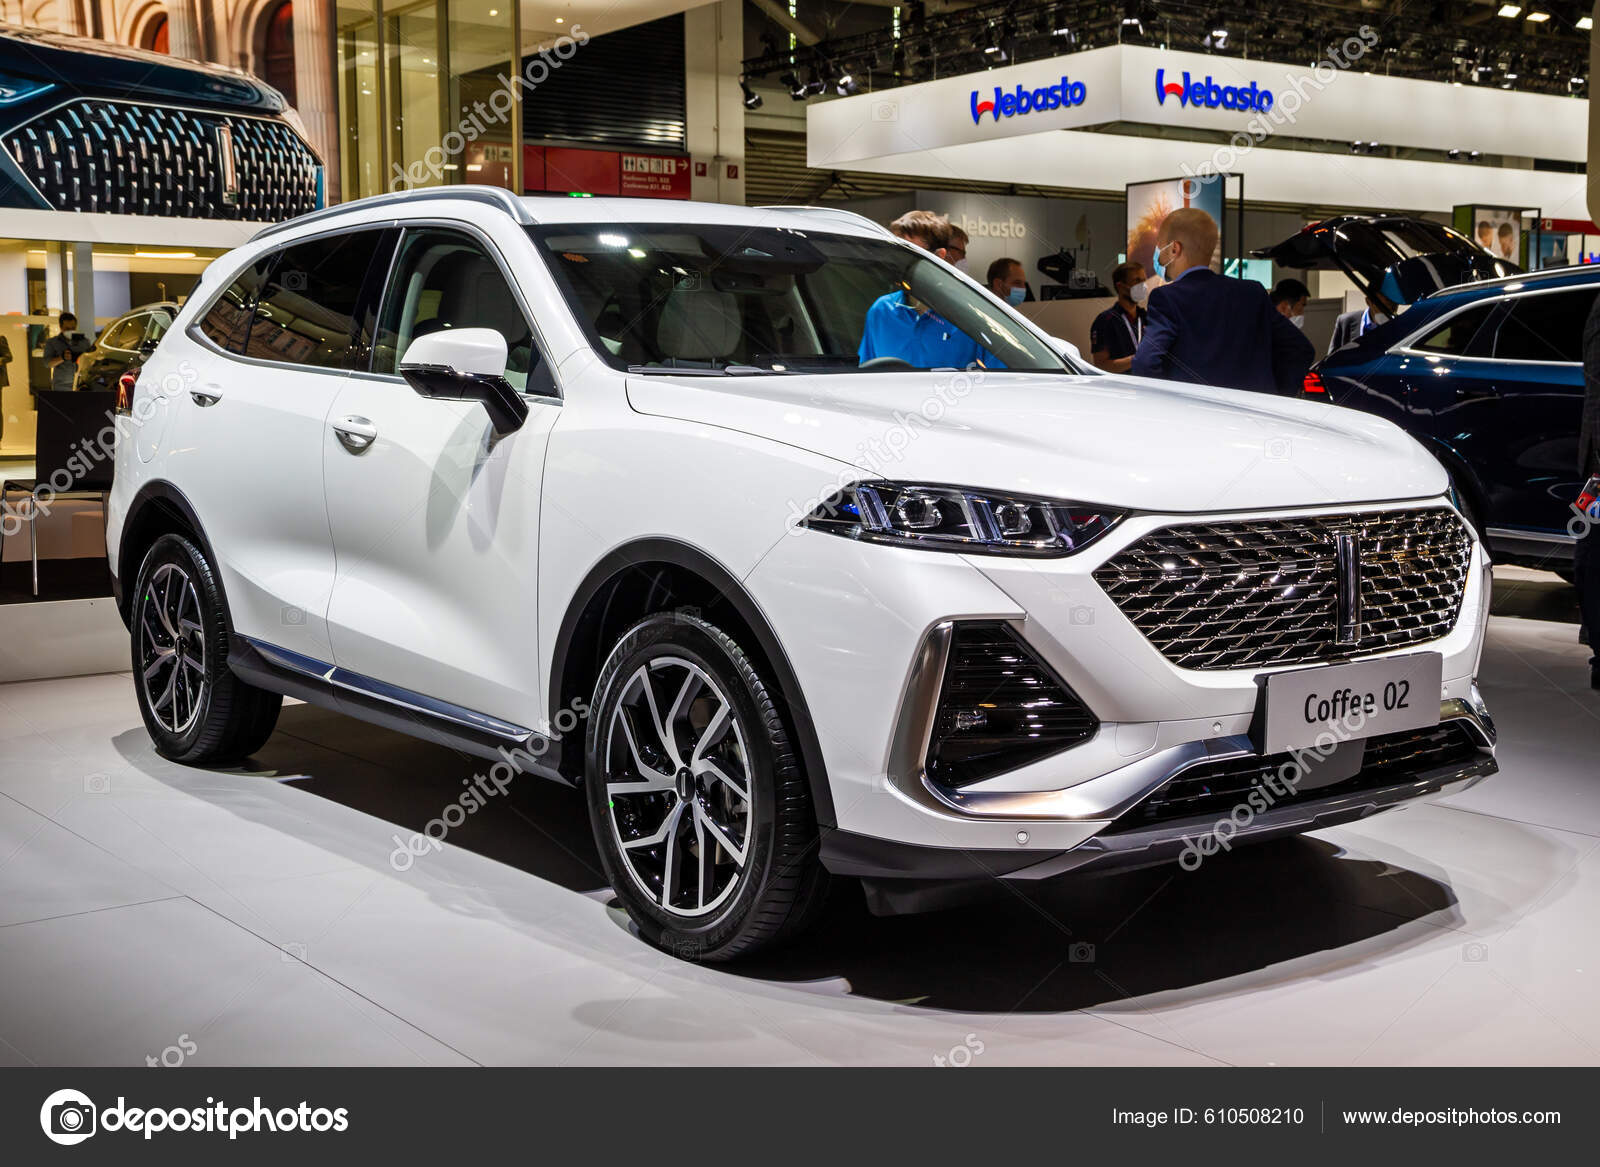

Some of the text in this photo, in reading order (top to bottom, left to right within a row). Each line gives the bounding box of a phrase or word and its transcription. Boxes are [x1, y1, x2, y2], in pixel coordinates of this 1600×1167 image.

[971, 76, 1086, 125] Webasto
[1156, 68, 1274, 113] Webasto
[1304, 679, 1410, 724] Coffee 02
